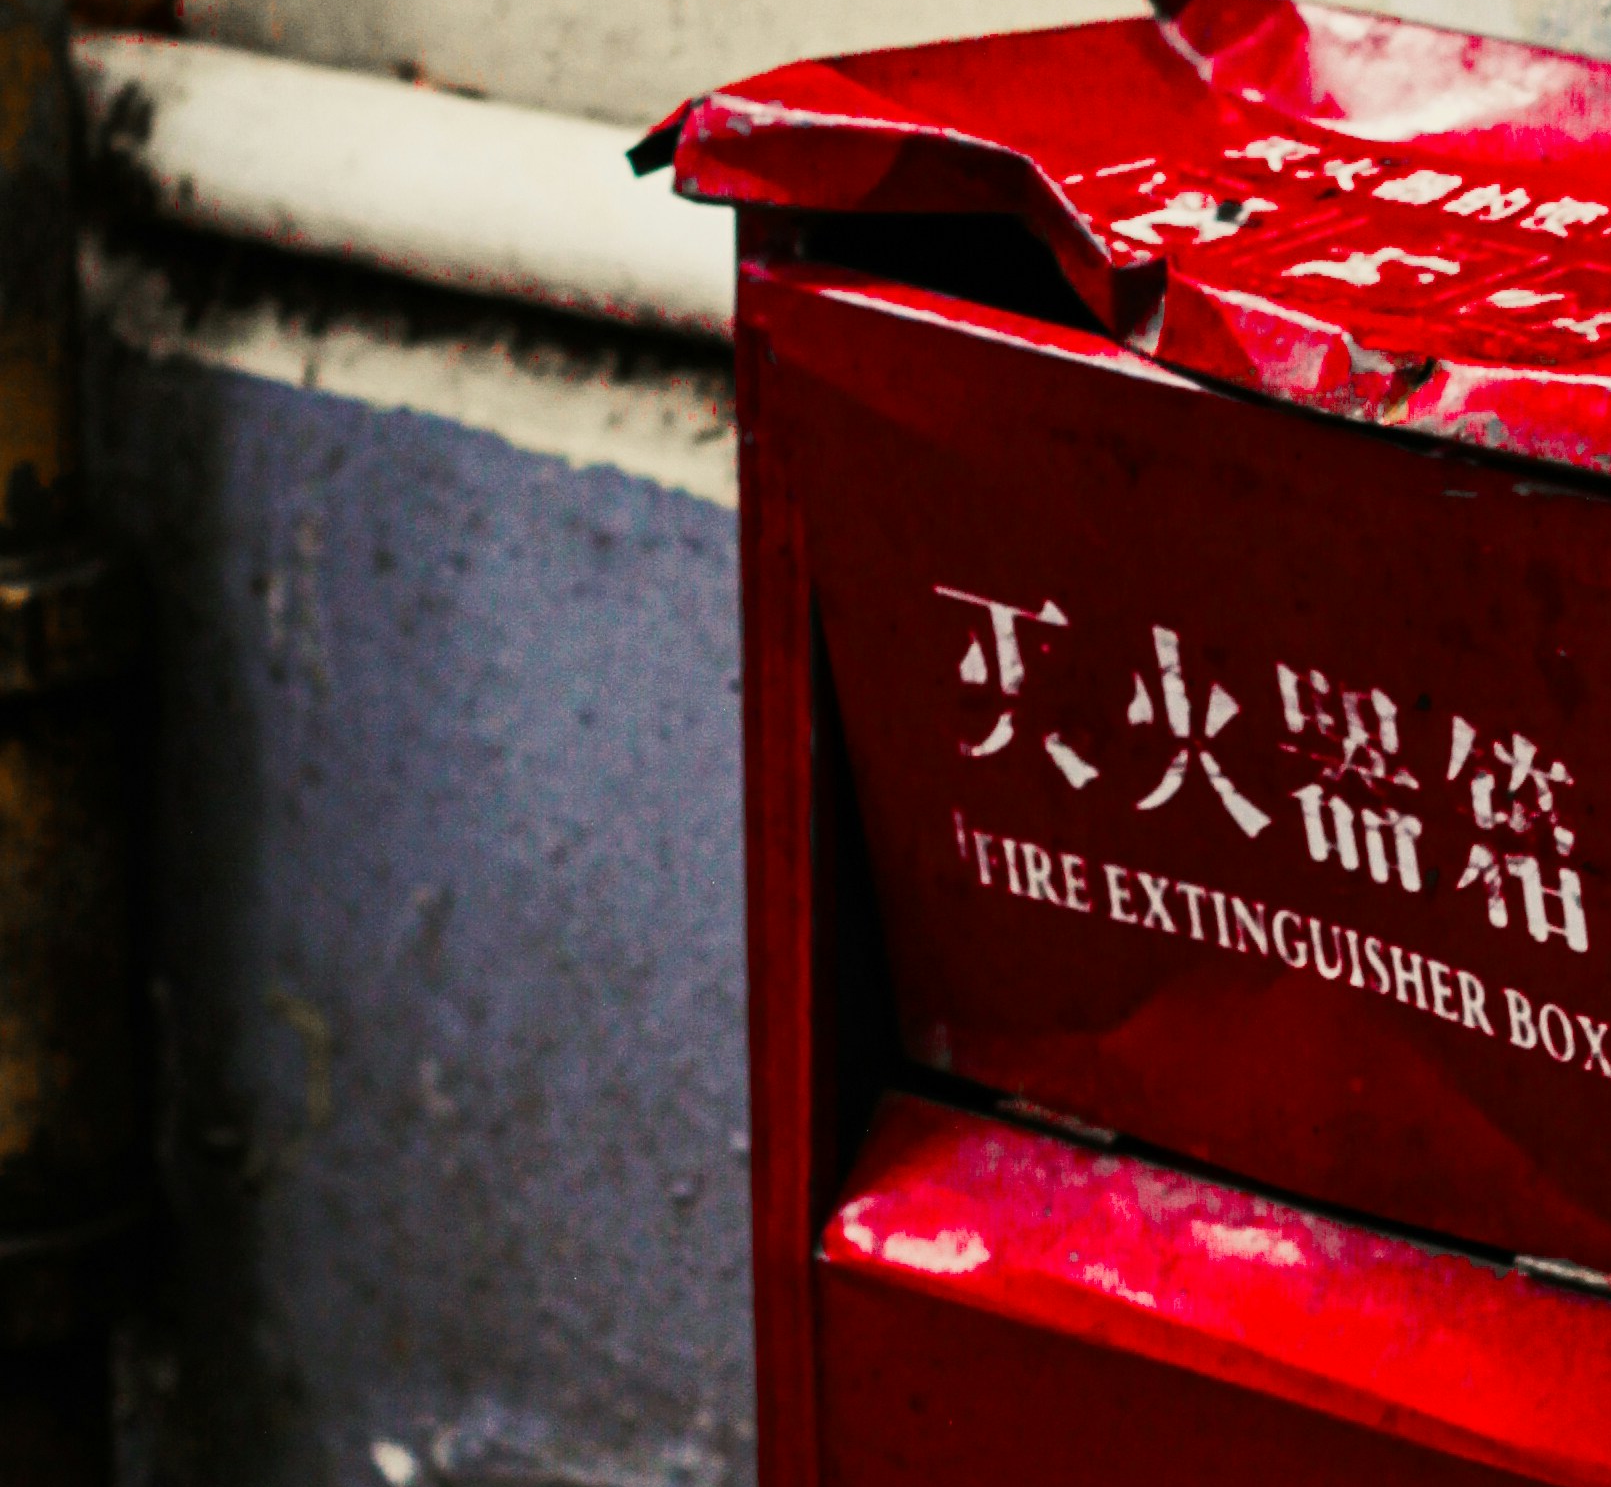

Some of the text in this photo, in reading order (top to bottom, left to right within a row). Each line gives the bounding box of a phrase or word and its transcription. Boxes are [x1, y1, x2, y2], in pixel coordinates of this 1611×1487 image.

[934, 585, 1590, 954] 灭火器箱
[972, 830, 1092, 913] FIRE
[1102, 863, 1495, 1037] EXTINGUISHER
